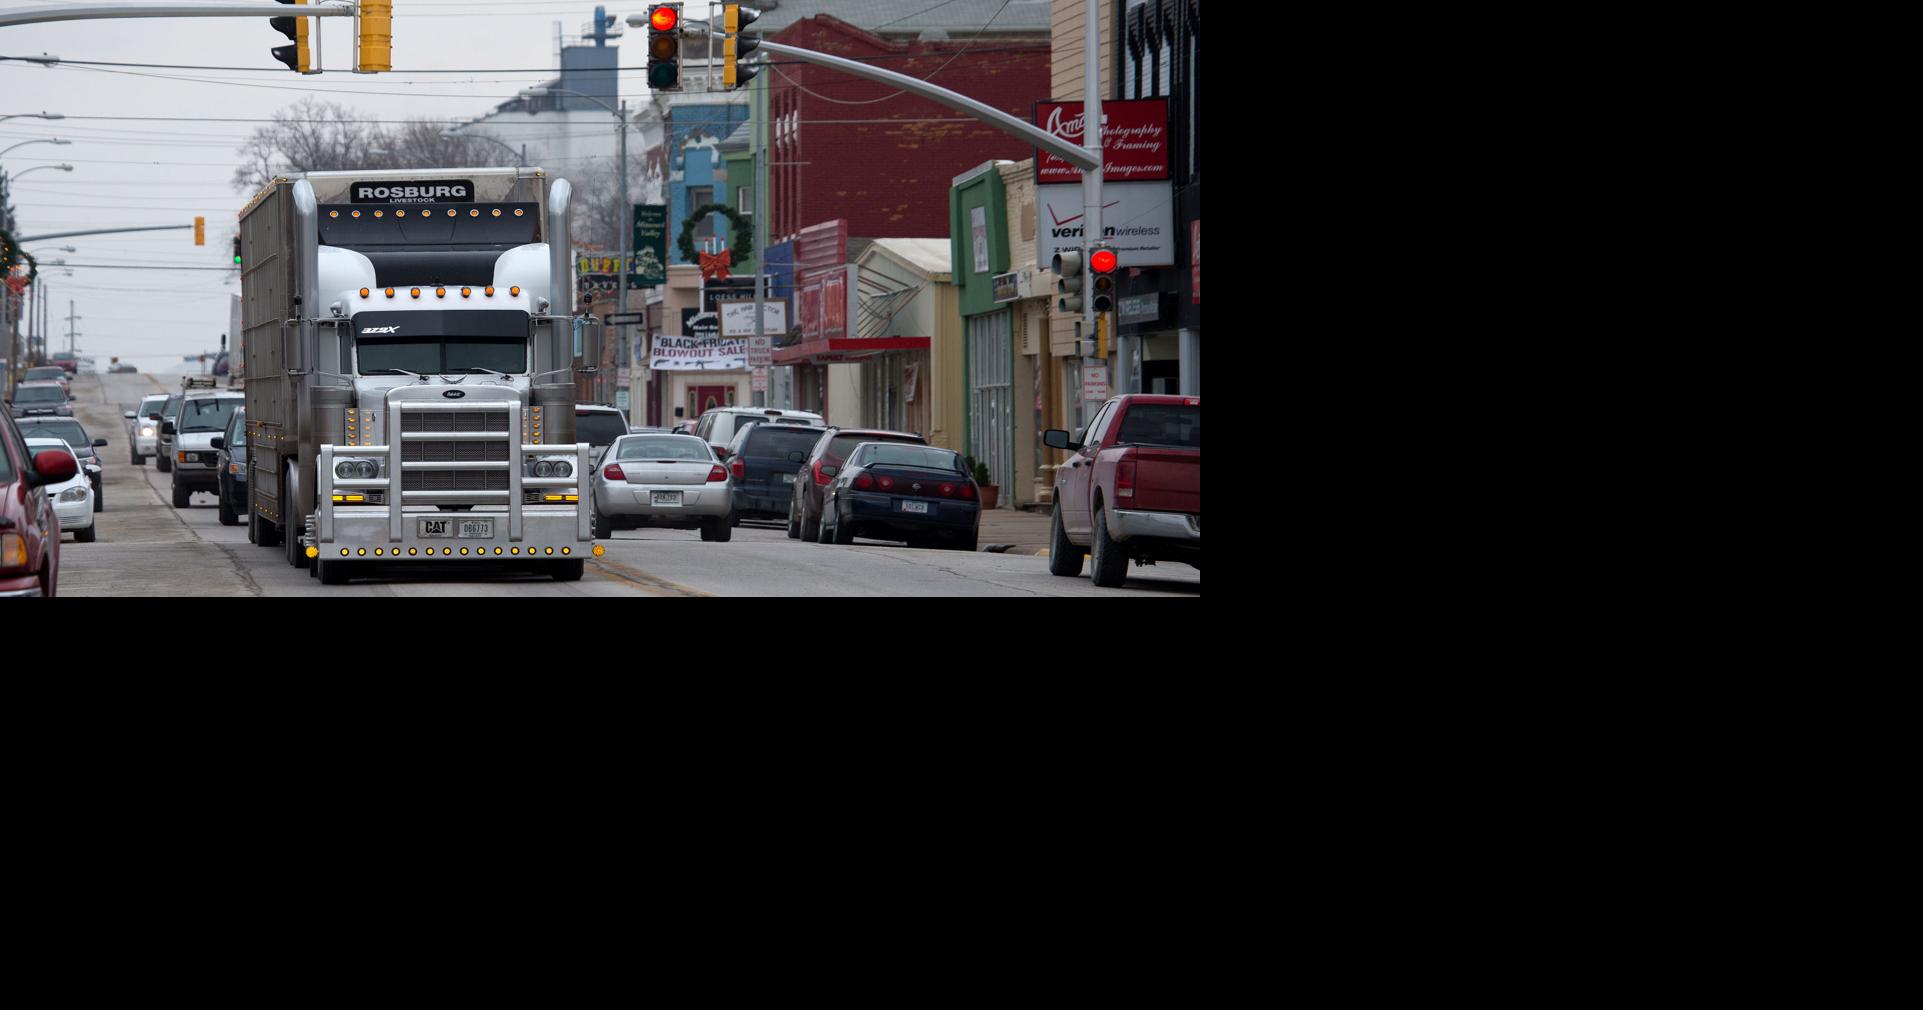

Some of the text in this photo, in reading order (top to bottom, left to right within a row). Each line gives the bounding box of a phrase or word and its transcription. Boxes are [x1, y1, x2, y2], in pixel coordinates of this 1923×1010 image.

[1113, 139, 1160, 152] Framing
[358, 185, 467, 198] ROSBURG
[1052, 225, 1160, 238] verin wireless
[660, 337, 698, 349] BLACK
[653, 345, 746, 358] BLOWOUT SALE
[425, 521, 447, 533] CAT
